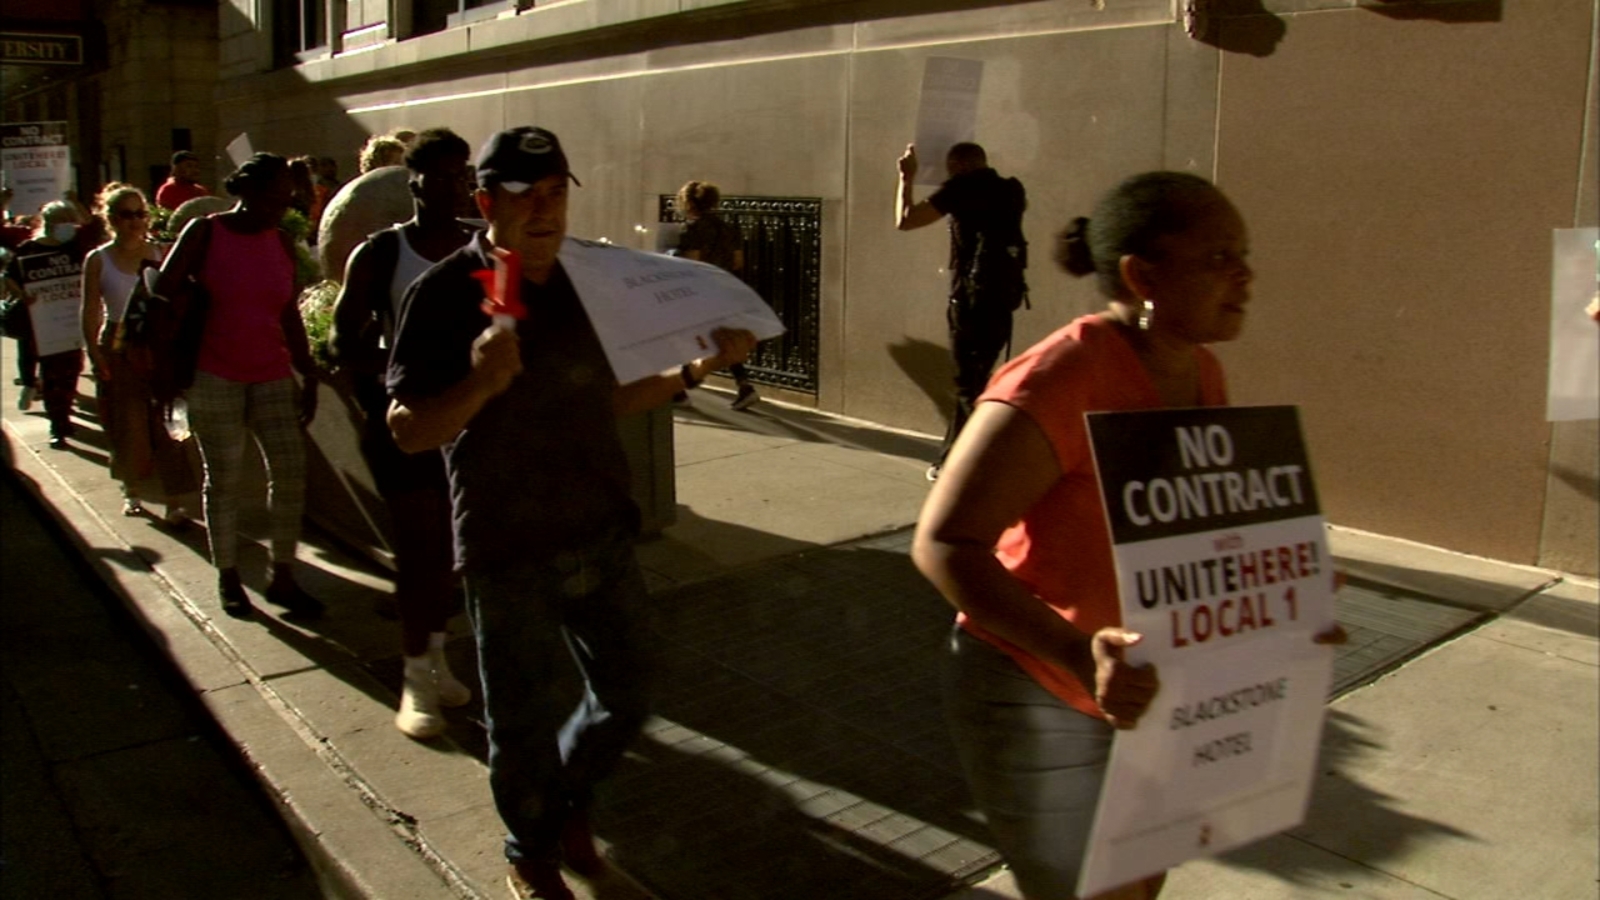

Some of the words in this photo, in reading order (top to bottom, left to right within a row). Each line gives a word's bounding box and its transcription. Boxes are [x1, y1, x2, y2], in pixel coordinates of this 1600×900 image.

[20, 126, 39, 136] NO
[27, 262, 81, 280] CONTRA
[48, 254, 70, 266] NO
[1175, 425, 1234, 469] NO
[1123, 465, 1304, 526] CONTRACT
[1135, 541, 1320, 609] UNITEHERE!
[1170, 593, 1276, 649] LOCAL
[1284, 586, 1297, 621] 1
[1169, 677, 1288, 730] BLACKSTONE
[1193, 732, 1252, 767] HOTEL
